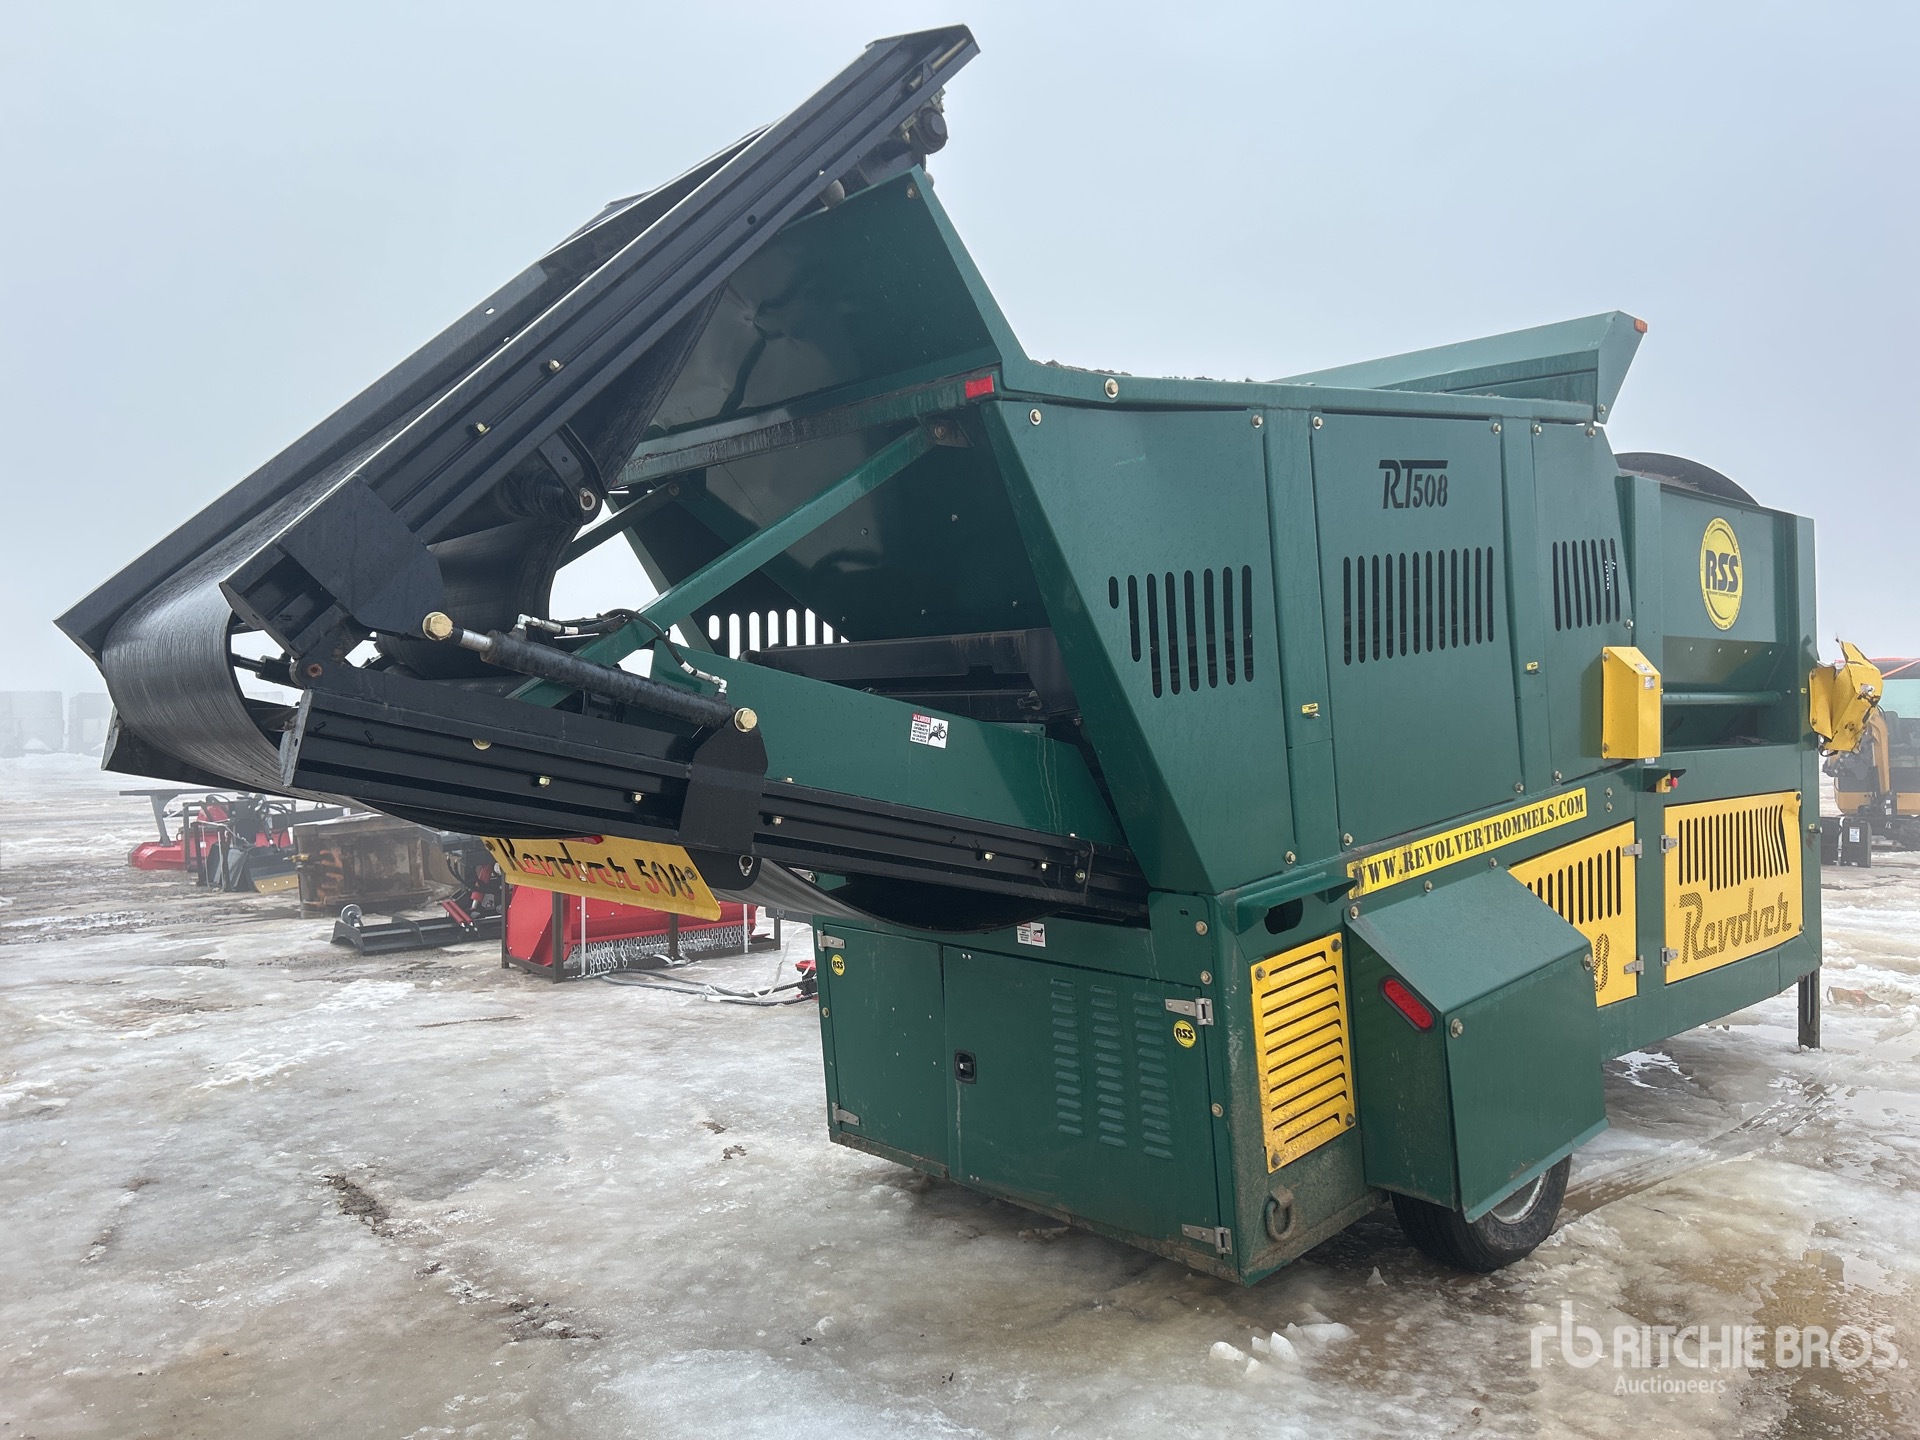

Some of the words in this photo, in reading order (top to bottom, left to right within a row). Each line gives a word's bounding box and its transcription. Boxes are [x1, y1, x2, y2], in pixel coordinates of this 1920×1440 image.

[1379, 460, 1448, 509] RT508
[1705, 549, 1739, 593] RSS
[1352, 794, 1584, 889] WWW.REVOLVERTROMMELS.COM
[634, 858, 695, 900] 508
[1679, 888, 1792, 964] Revolver
[832, 960, 844, 969] RSS
[1175, 1027, 1194, 1040] RSS
